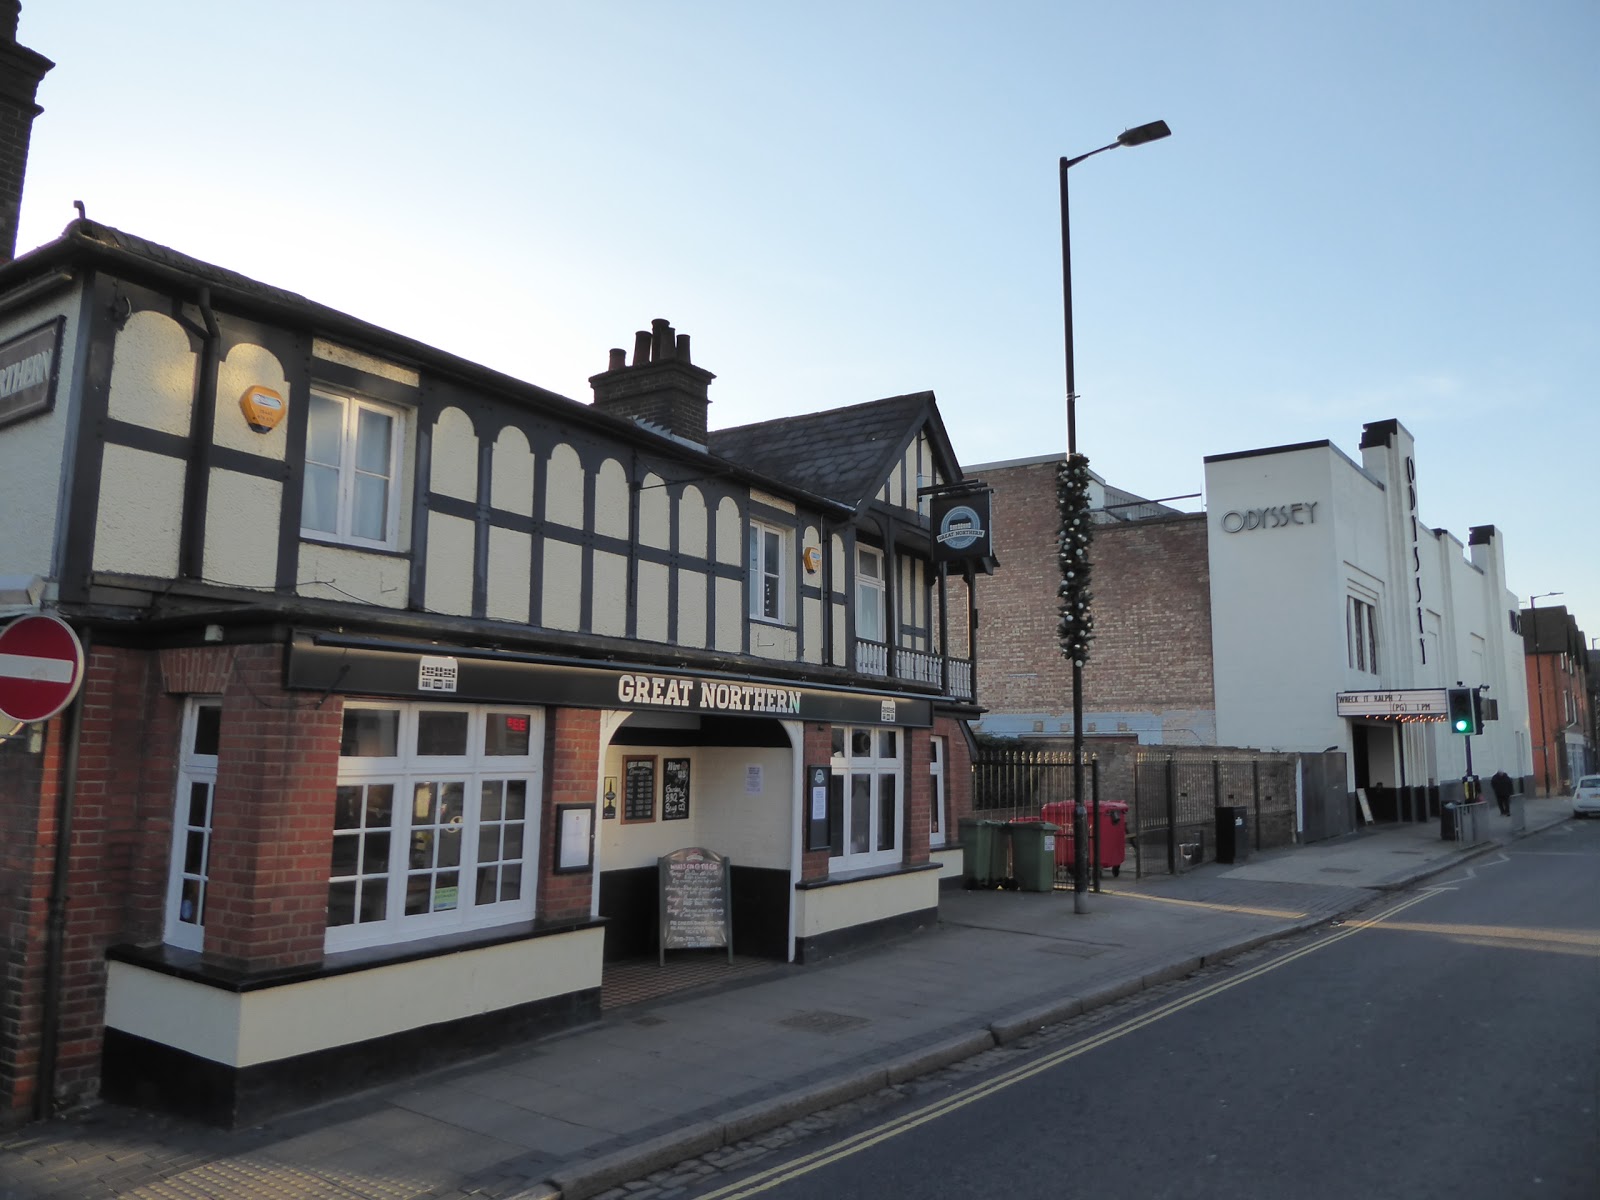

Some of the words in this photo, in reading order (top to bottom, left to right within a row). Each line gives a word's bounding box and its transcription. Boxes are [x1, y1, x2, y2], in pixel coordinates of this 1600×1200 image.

[1221, 501, 1318, 533] ODYSSEY
[938, 532, 954, 540] GREAT
[617, 674, 694, 707] GREAT
[699, 682, 802, 714] NORTHERN
[1339, 695, 1358, 703] WRECK
[1374, 694, 1392, 702] RALPH
[1398, 694, 1403, 702] 2
[1392, 703, 1407, 712] (PG)
